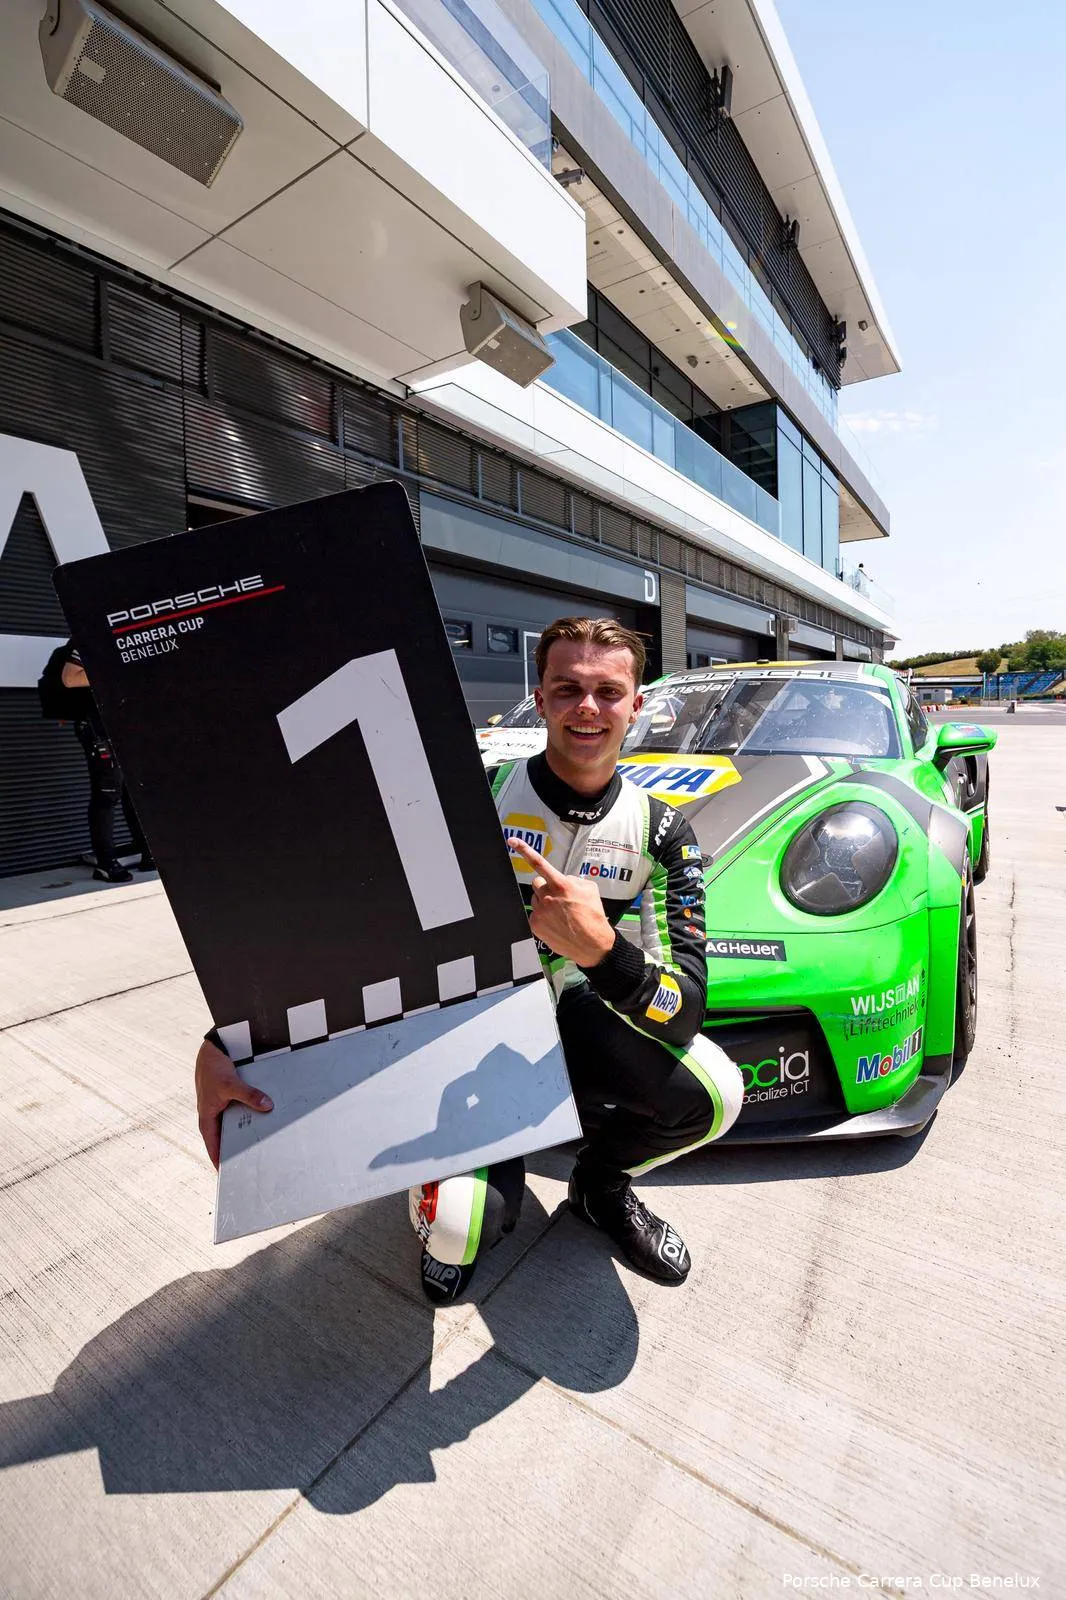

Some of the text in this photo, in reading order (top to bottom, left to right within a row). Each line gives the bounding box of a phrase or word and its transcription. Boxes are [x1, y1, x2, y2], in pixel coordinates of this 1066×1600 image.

[106, 575, 264, 626] PORSCHE
[116, 617, 204, 650] CARRERA CUP
[121, 639, 179, 663] BENELUX
[276, 648, 474, 931] 1
[580, 862, 631, 881] Mobil 1
[706, 941, 779, 956] AGHeuer
[653, 986, 680, 1013] NAPA
[739, 1046, 810, 1091] ocia
[856, 1036, 911, 1084] Mobil
[742, 1080, 810, 1104] ocialize ICT
